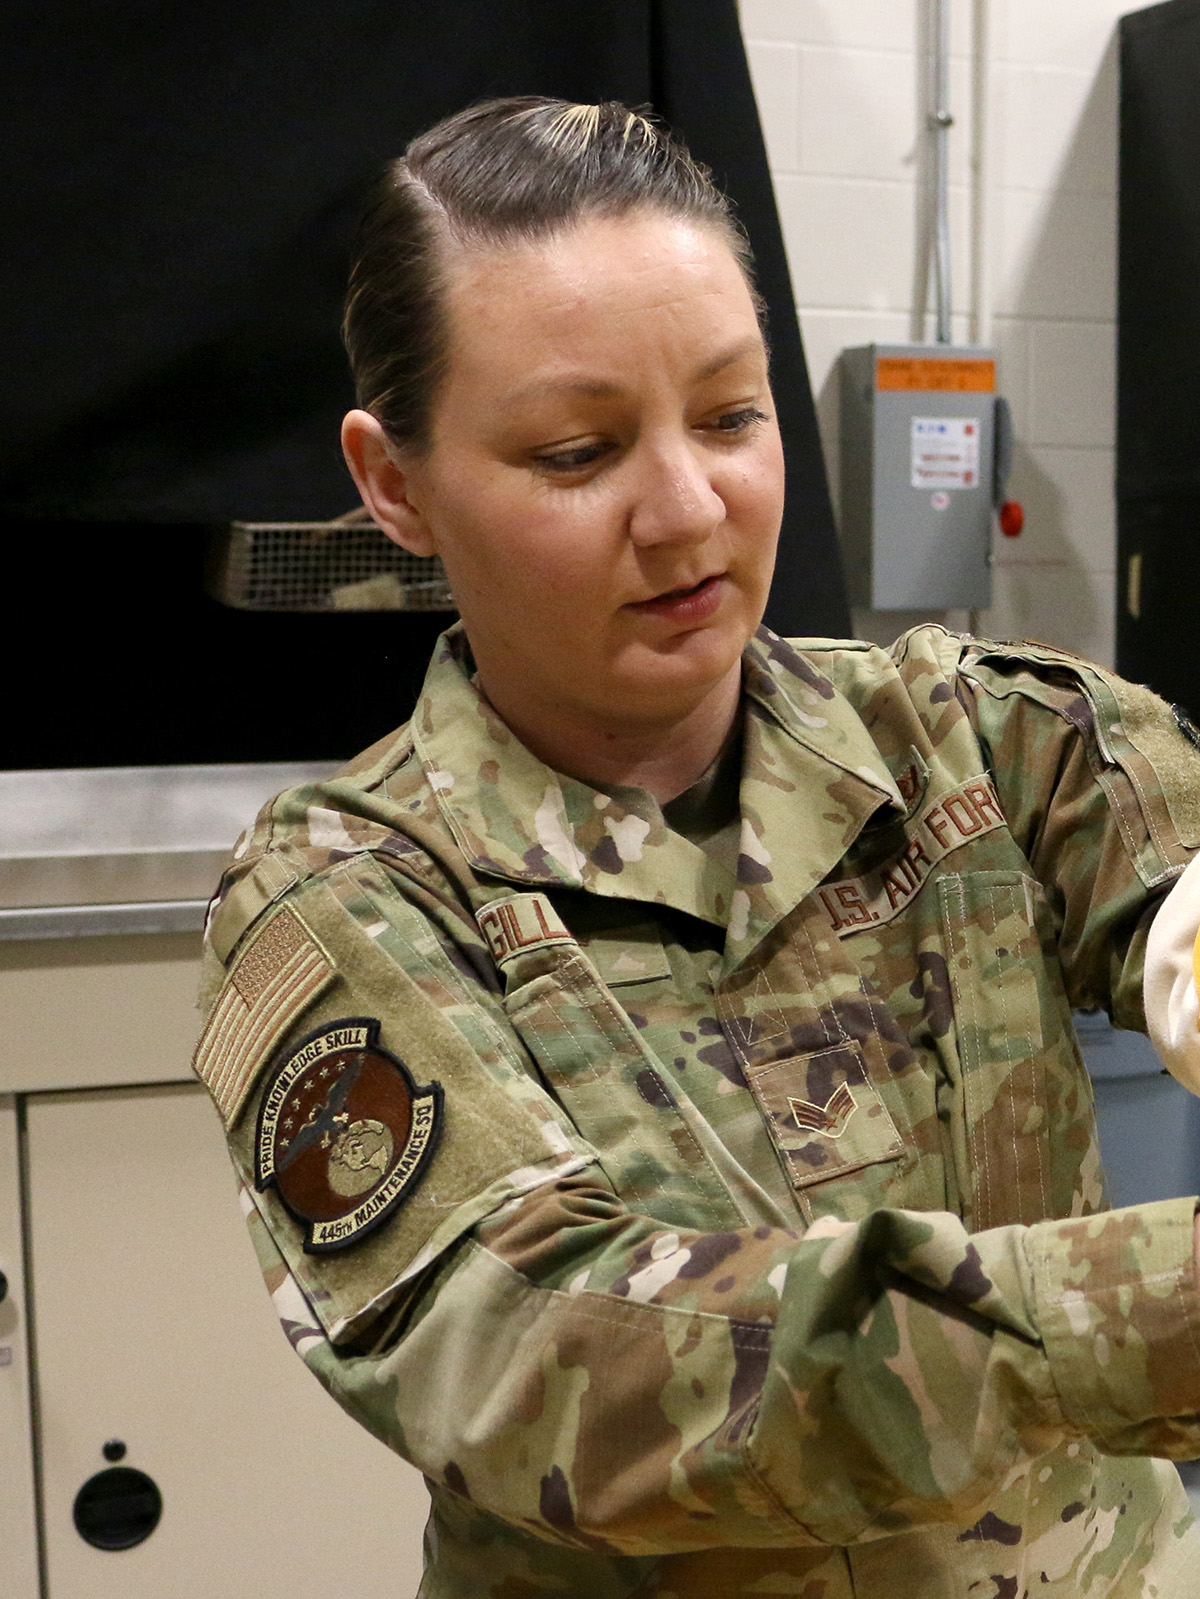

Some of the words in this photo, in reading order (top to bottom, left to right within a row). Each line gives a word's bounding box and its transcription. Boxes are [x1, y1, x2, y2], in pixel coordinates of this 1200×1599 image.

[880, 838, 932, 911] AIR
[325, 1029, 362, 1051] SKILL
[265, 1042, 323, 1123] KNOWLEDGE
[262, 1125, 274, 1175] PRIDE
[353, 1129, 428, 1227] MAINTENANCE
[416, 1105, 432, 1125] SQ
